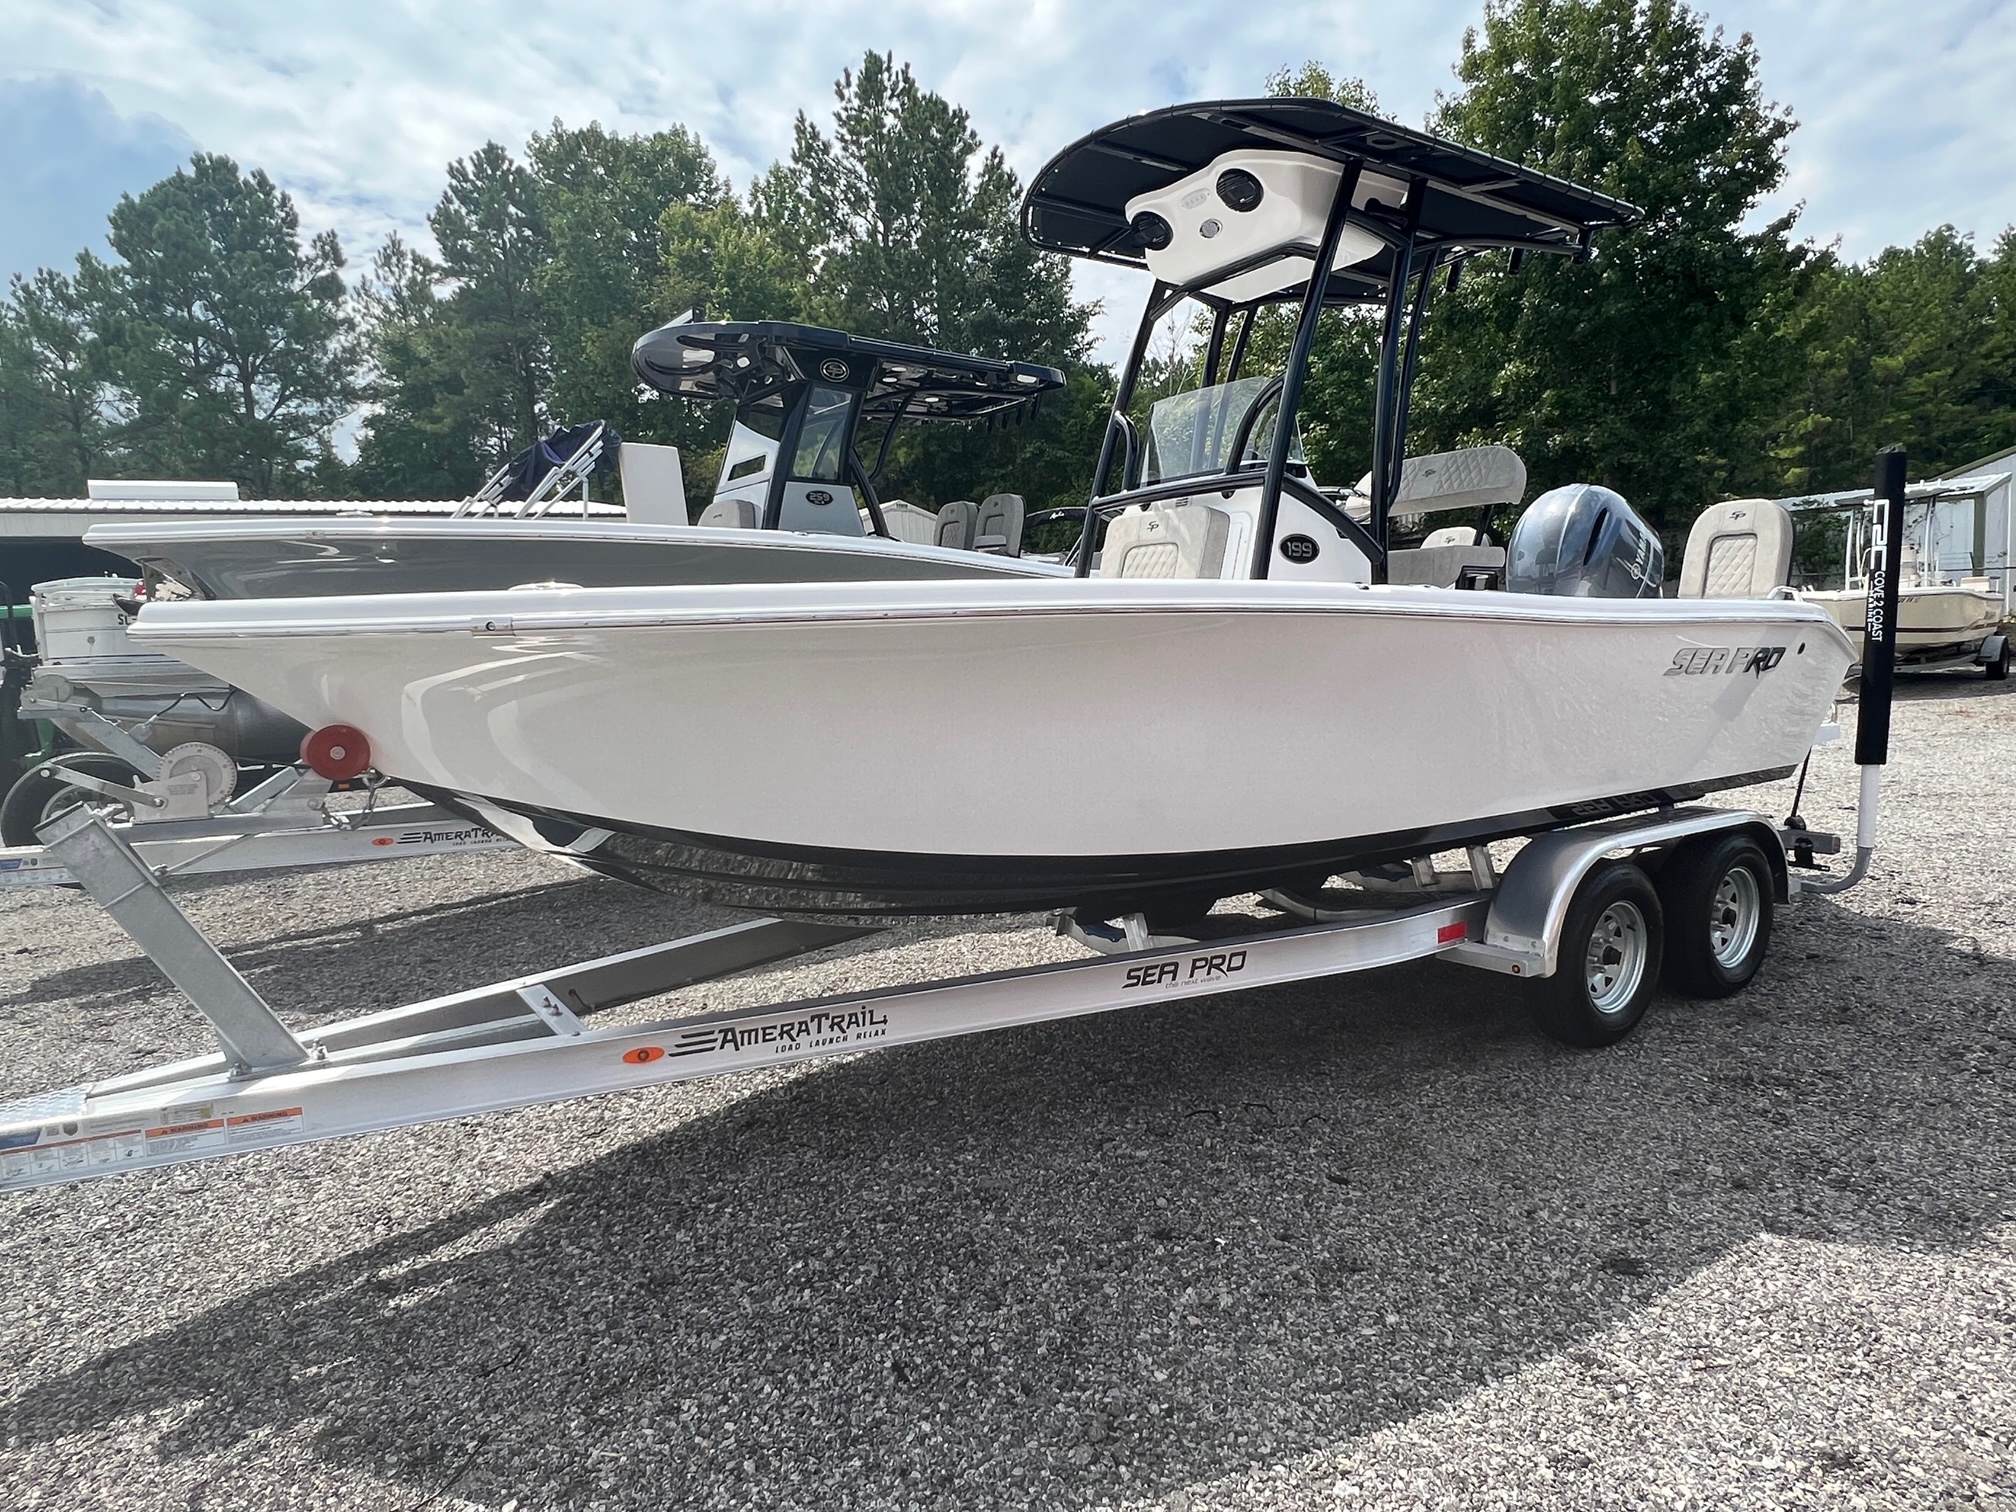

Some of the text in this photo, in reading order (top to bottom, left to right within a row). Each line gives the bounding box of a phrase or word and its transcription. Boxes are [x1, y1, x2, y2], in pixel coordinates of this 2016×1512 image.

[1287, 541, 1313, 557] 199
[1874, 571, 1886, 598] COVE
[1871, 608, 1884, 642] COAST
[1663, 647, 1787, 680] SEA PRO
[1122, 950, 1248, 989] SEA PRO
[775, 1028, 887, 1053] LOAD LAUNCH RELAX
